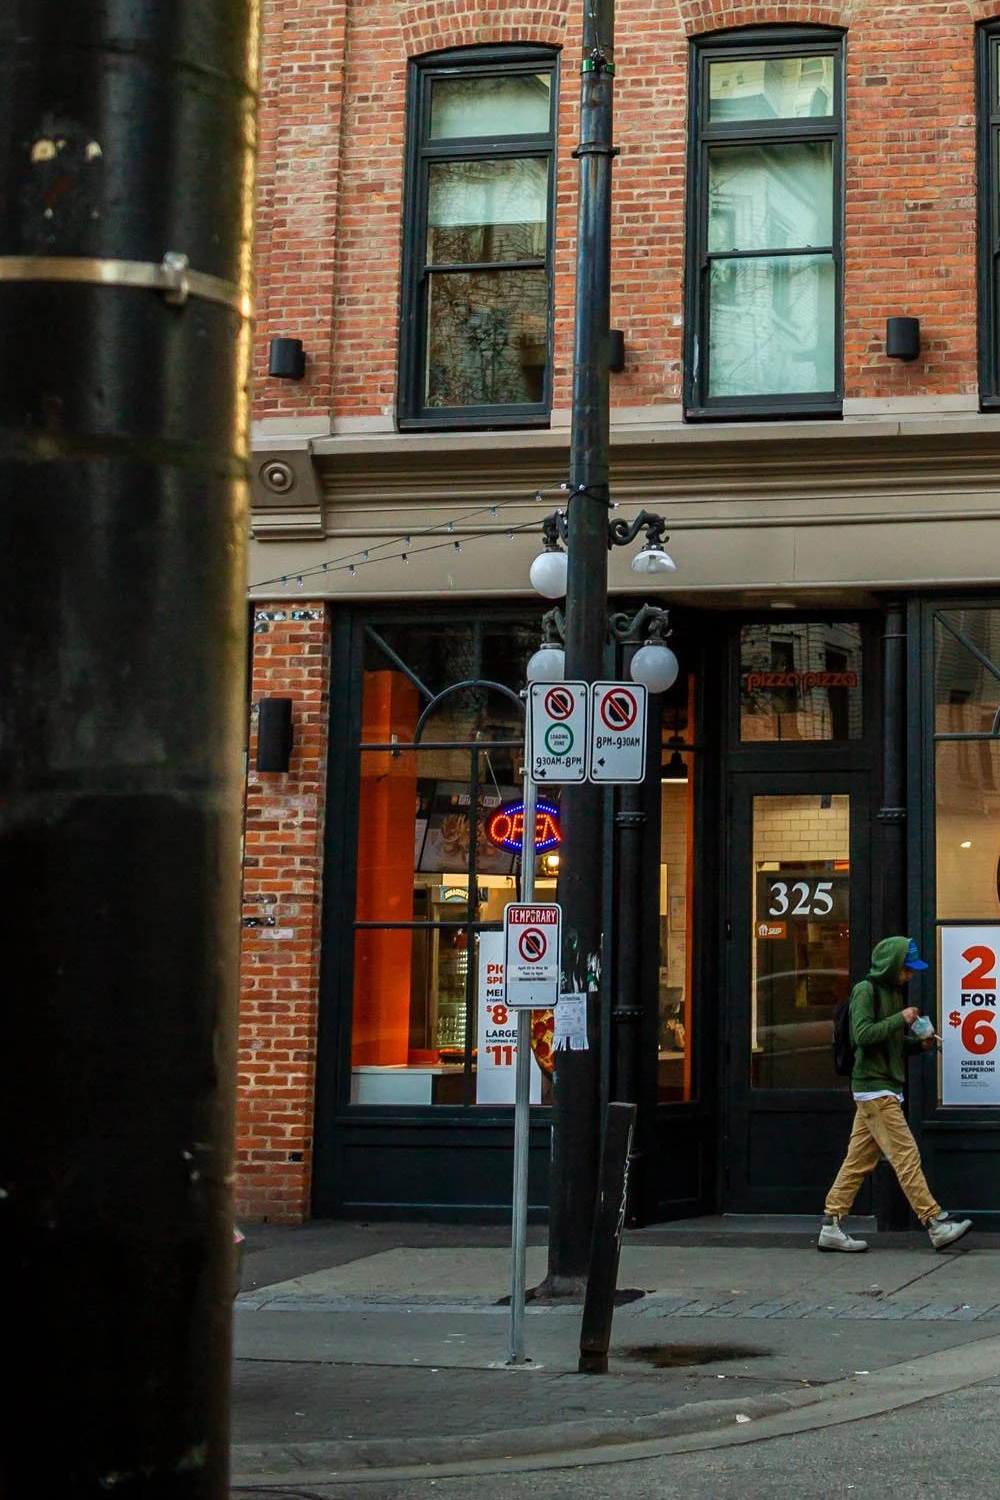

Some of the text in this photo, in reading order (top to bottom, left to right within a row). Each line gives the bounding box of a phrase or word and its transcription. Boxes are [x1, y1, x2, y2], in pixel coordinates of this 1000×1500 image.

[747, 671, 857, 692] pizza pizza
[769, 882, 833, 915] 325
[510, 909, 556, 923] TEMPORARY
[961, 945, 996, 990] 2
[961, 993, 996, 1006] FOR
[949, 1009, 997, 1055] $6
